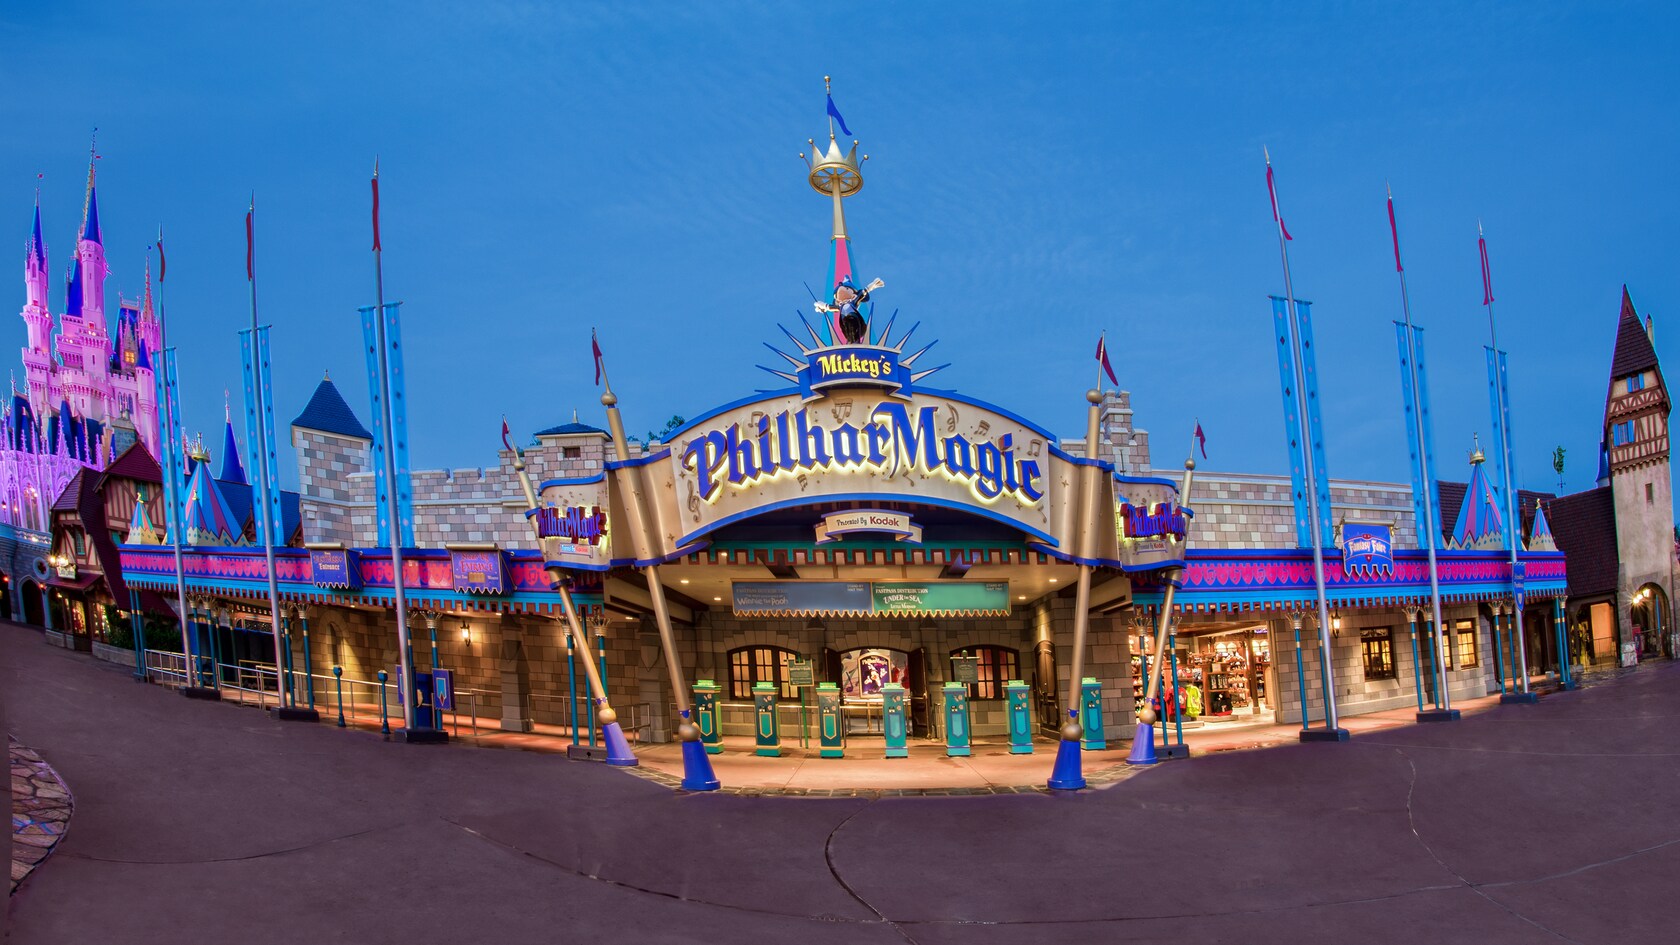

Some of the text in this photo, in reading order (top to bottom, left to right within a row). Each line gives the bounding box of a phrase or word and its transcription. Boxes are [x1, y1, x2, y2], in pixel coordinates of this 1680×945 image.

[816, 353, 892, 378] Mickey's
[682, 402, 1044, 501] PhilharMagic
[869, 516, 899, 526] Kodak
